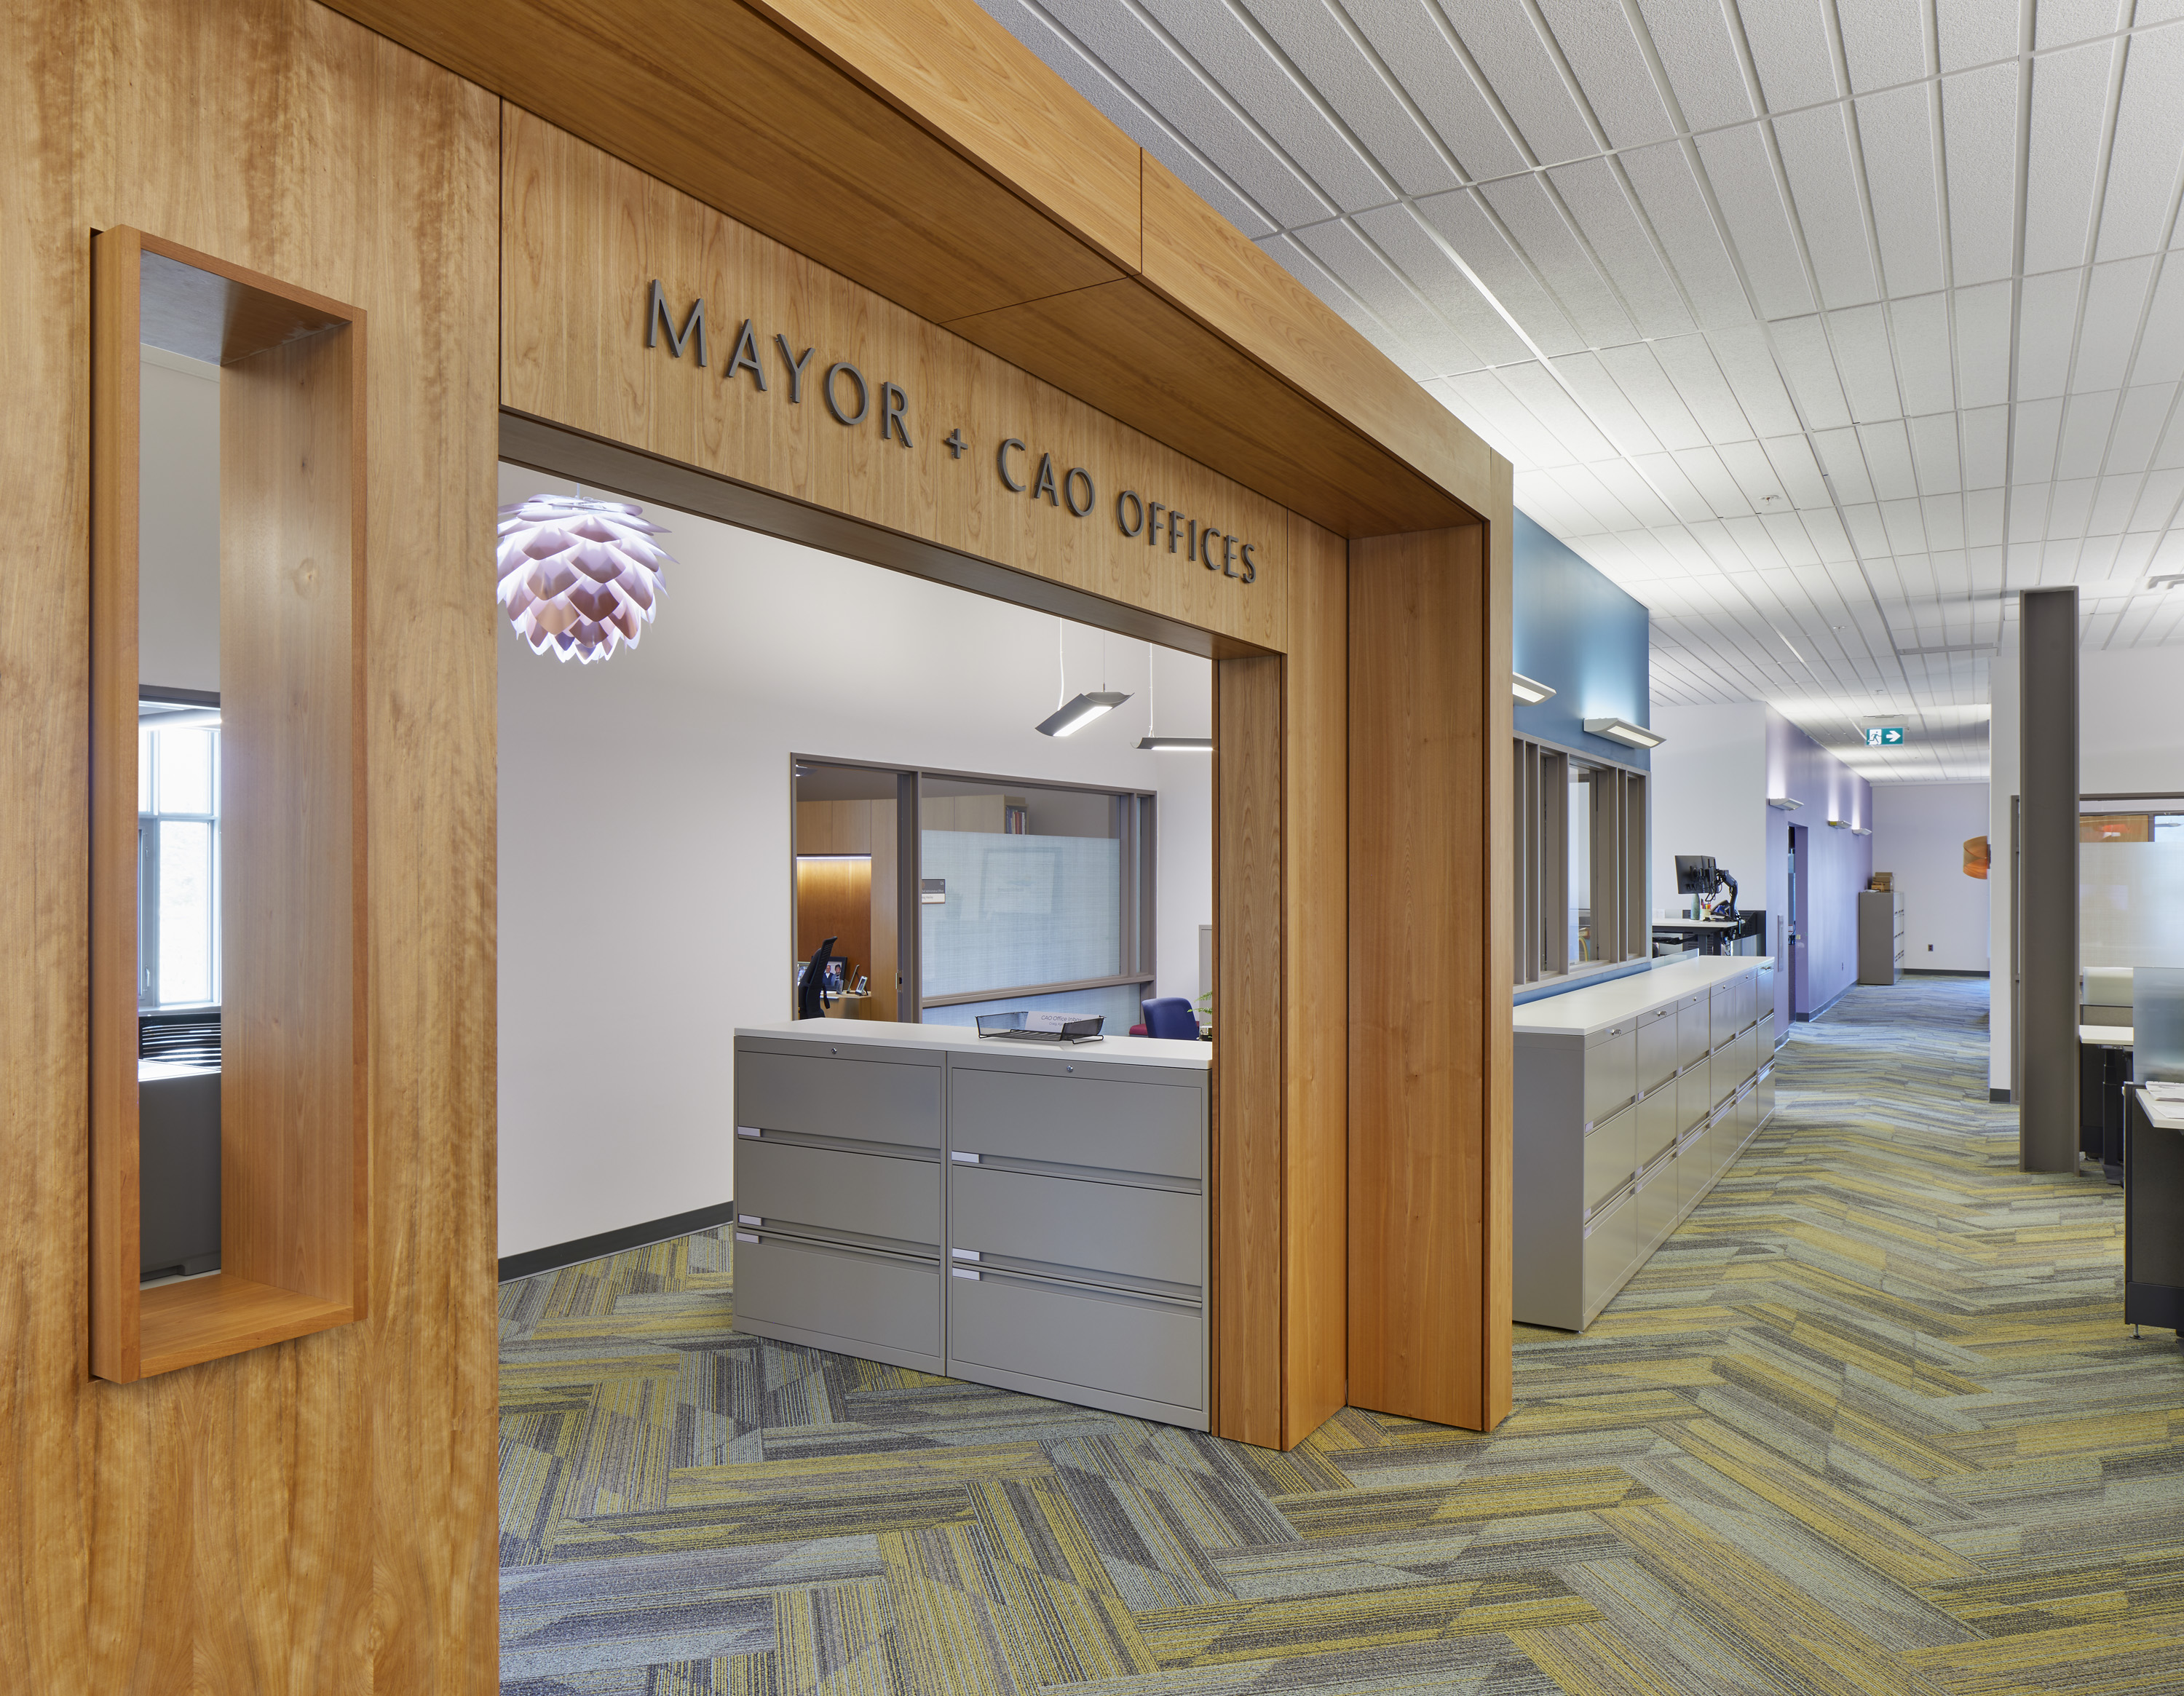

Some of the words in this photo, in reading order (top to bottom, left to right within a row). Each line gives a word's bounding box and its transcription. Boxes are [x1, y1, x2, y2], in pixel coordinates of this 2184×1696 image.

[646, 279, 914, 449] MAYOR
[945, 428, 969, 459] +
[997, 437, 1096, 518] CAO
[1116, 490, 1257, 585] OFFICES
